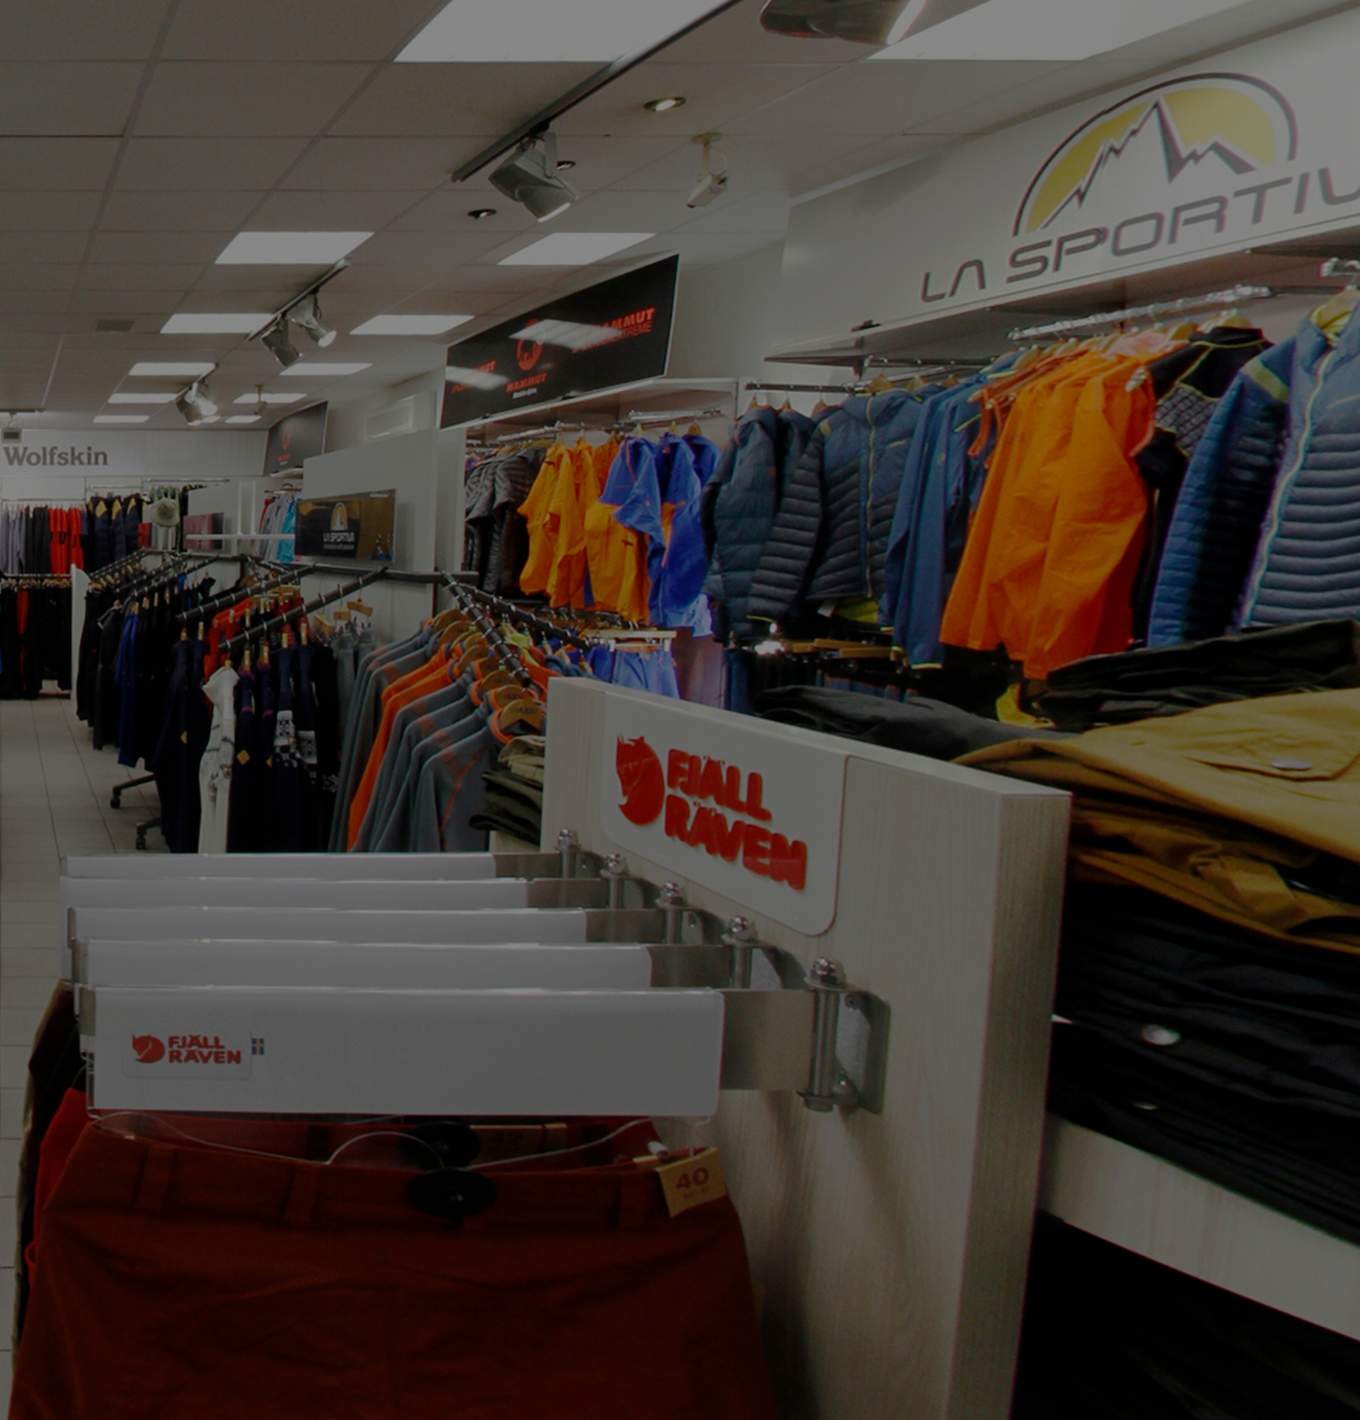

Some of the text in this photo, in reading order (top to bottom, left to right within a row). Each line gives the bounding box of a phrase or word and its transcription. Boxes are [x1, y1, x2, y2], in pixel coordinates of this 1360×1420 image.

[921, 258, 986, 303] LA
[3, 446, 109, 466] Wolfskin
[667, 749, 772, 821] FJÄLL
[665, 795, 807, 890] RÄVEN
[168, 1035, 225, 1049] FJÄLL
[676, 1167, 709, 1189] 40
